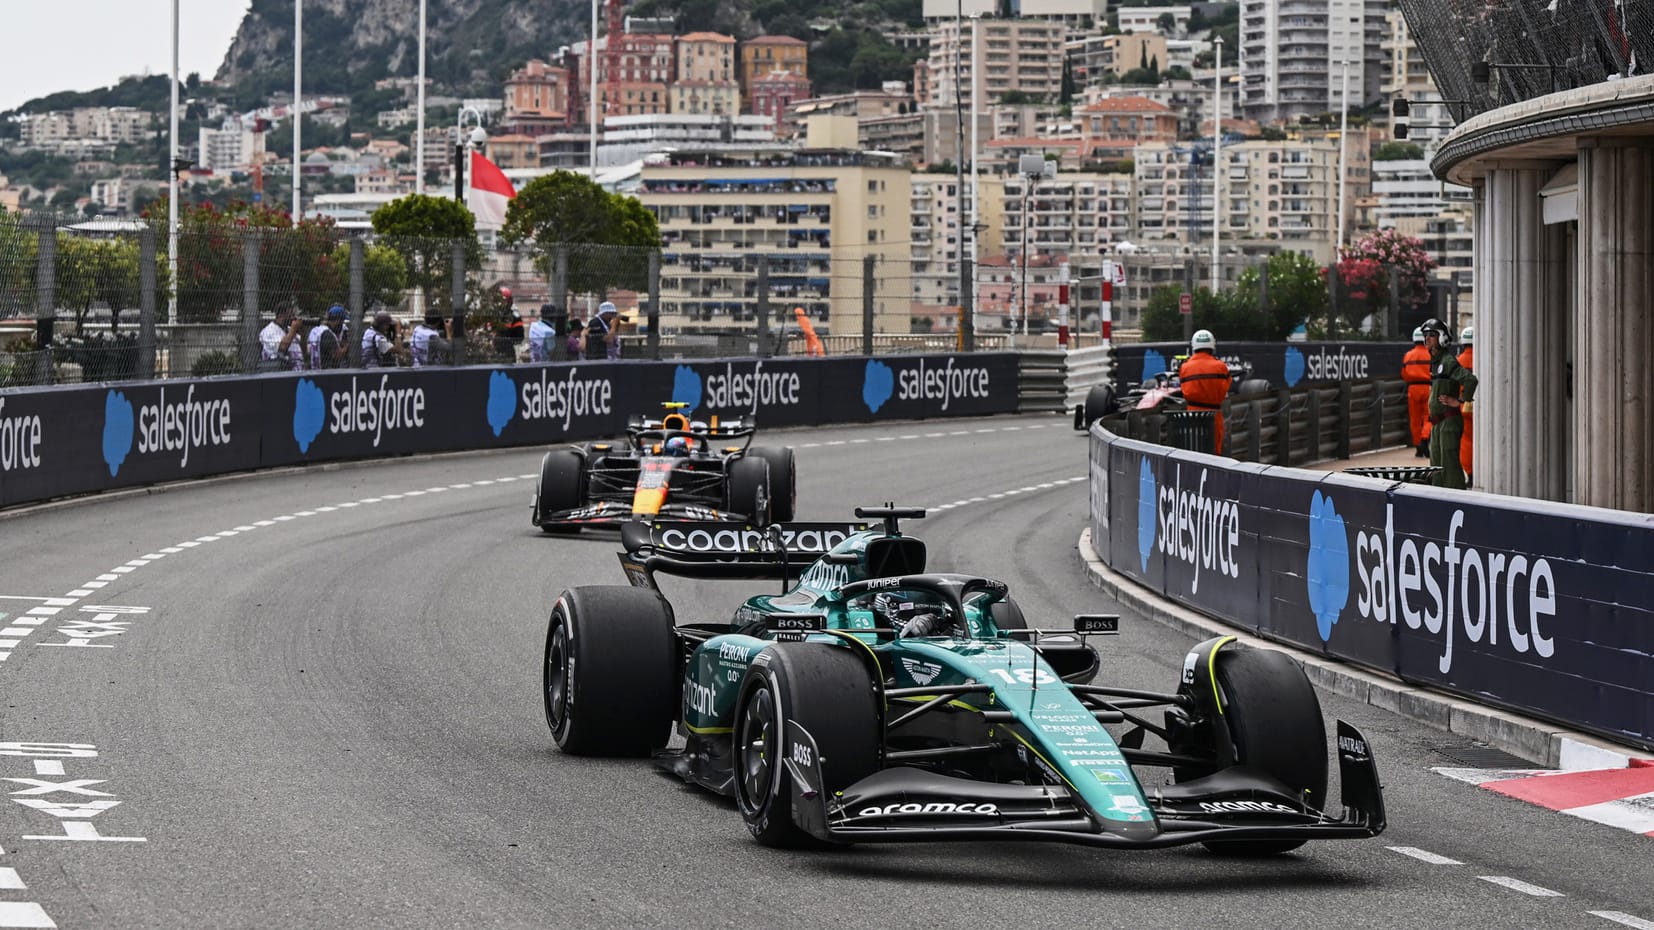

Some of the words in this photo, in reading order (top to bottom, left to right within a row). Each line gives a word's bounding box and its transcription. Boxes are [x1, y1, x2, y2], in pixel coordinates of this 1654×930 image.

[1308, 345, 1368, 380] salesforce
[522, 367, 612, 432] salesforce
[706, 361, 800, 415] salesforce
[899, 357, 989, 411] salesforce
[138, 384, 231, 467] salesforce
[329, 374, 425, 447] salesforce
[1158, 462, 1240, 595] salesforce
[1356, 502, 1557, 674] salesforce
[777, 619, 813, 629] BOSS
[1085, 619, 1113, 630] BOSS
[720, 641, 751, 662] PERONI
[989, 668, 1057, 685] 18
[793, 742, 811, 767] BOSS
[858, 802, 999, 816] aramco
[1199, 801, 1298, 813] aramco
